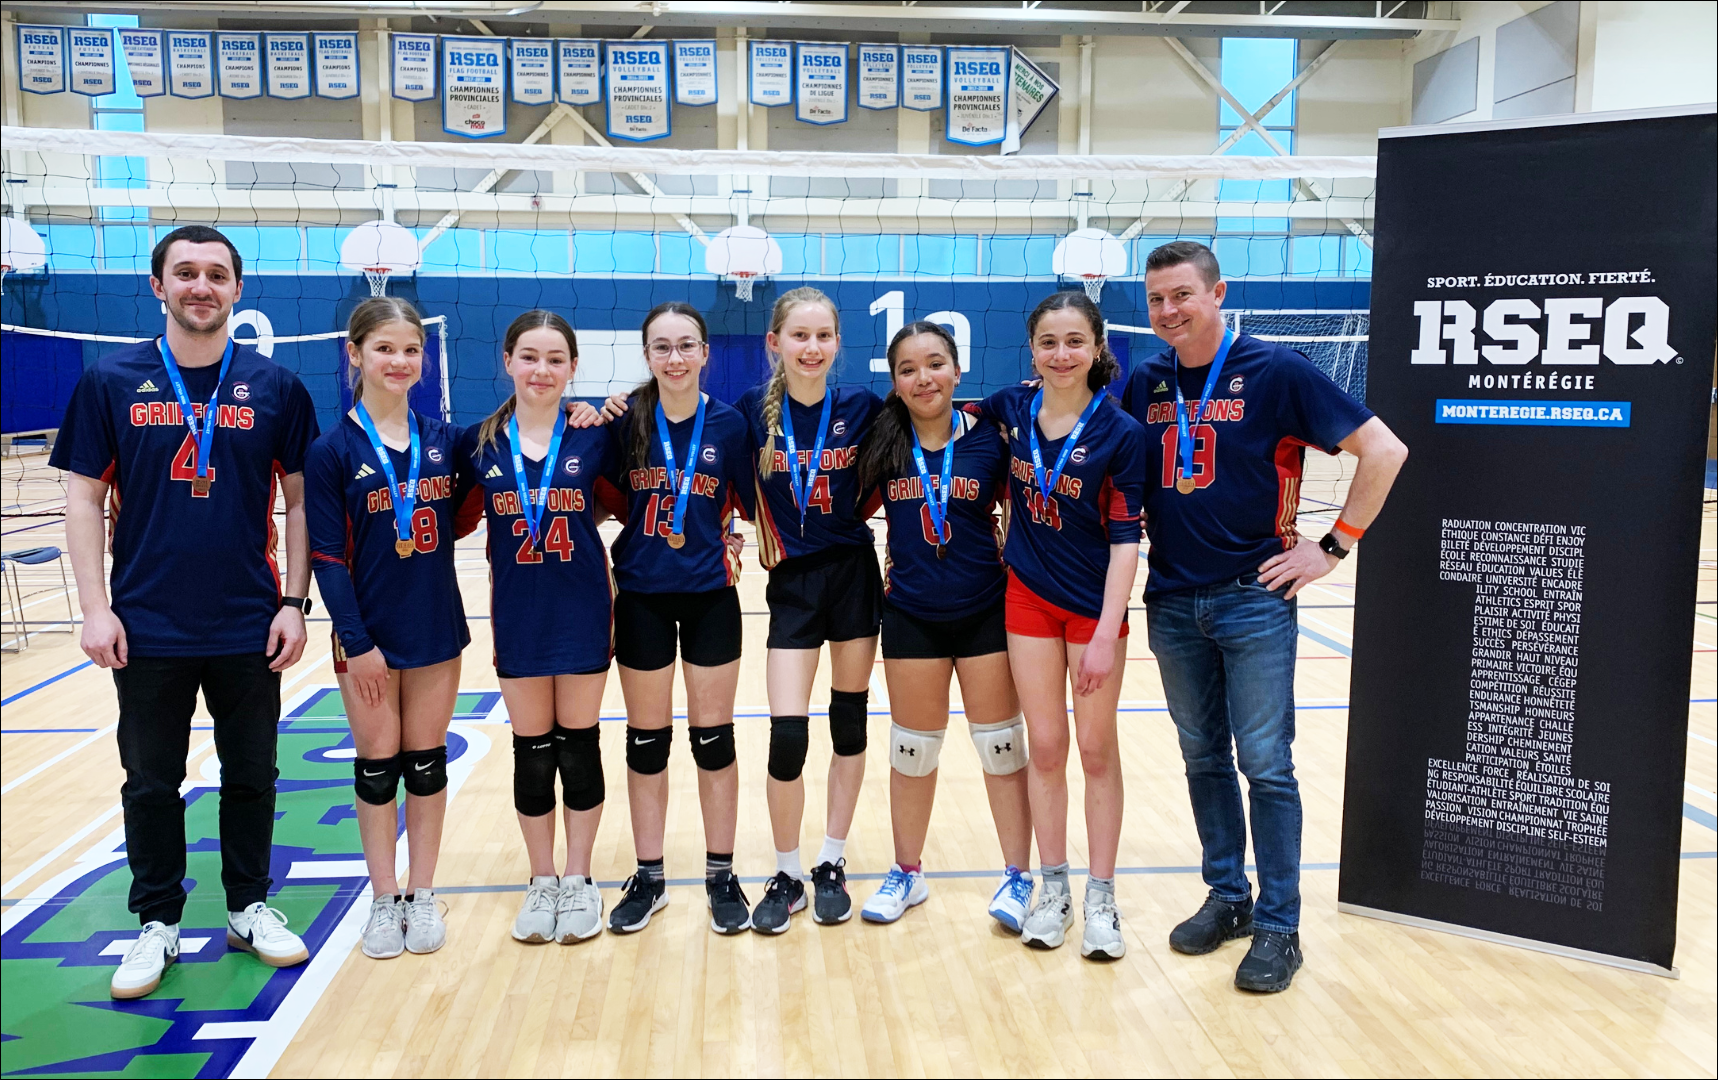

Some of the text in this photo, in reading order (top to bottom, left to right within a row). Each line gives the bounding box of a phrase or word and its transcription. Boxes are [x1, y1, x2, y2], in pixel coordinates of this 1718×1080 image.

[24, 34, 58, 45] RSEQ
[74, 36, 109, 47] RSEQ
[123, 35, 157, 45] RSEQ
[173, 38, 207, 47] RSEQ
[222, 41, 255, 50] RSEQ
[270, 41, 304, 51] RSEQ
[319, 39, 352, 49] RSEQ
[398, 41, 431, 51] RSEQ
[449, 52, 499, 67] RSEQ
[516, 48, 549, 57] RSEQ
[563, 48, 595, 58] RSEQ
[612, 51, 661, 65] RSEQ
[679, 47, 711, 56] RSEQ
[756, 47, 787, 57] RSEQ
[803, 55, 842, 67] RSEQ
[863, 53, 894, 62] RSEQ
[907, 54, 938, 63] RSEQ
[954, 62, 1001, 75] RSEQ
[1015, 63, 1030, 79] MERCI
[1034, 79, 1045, 91] NOS
[450, 86, 499, 94] CHAMPIONNES
[1014, 72, 1044, 103] TENAIRES
[450, 95, 499, 103] PROVINCIALES
[954, 95, 1001, 103] CHAMPIONNES
[1427, 268, 1656, 288] SPORT. ÉDUCATION. FIERTÉ.
[1411, 296, 1679, 365] RSEQ
[1468, 371, 1595, 390] MONTÉRÉGIE
[1442, 405, 1623, 421] MONTEREGIE.RSEQ.CA
[170, 429, 216, 498] 4
[759, 445, 858, 472] RFONS
[1161, 424, 1217, 489] 19
[1010, 454, 1083, 499] RIFONS
[367, 475, 452, 513] GRFONS
[644, 493, 686, 538] 13
[920, 501, 952, 545] 6
[1441, 519, 1586, 535] RADUATION CONCENTRATION VIC
[512, 516, 574, 564] 24
[1441, 528, 1585, 547] ÉTHIQUE CONSTANCE DÉFI ENJOY
[1440, 539, 1584, 557] BILETÉ DÉVELOPPEMENT DISCIPL
[1440, 549, 1584, 568] ÉCOLE RECONNAISSANCE STUDIE
[1439, 560, 1472, 572] RÉSEAU
[1476, 562, 1525, 575] ÉDUCATION
[1529, 567, 1563, 578] VALUES
[1439, 572, 1582, 590] CONDAIRE UNIVERSITÉ ENCADRE
[1476, 585, 1582, 601] ILITY SCHOOL ENTRAÎN
[1475, 596, 1581, 612] ATHLETICS ESPRIT SPOR
[1474, 606, 1580, 623] PLAISIR ACTIVITÉ PHYSI
[1472, 625, 1578, 644] É ETHICS DÉPASSEMENT
[1473, 617, 1579, 634] ESTIME DE SOI ÉDUCATI
[1472, 637, 1578, 656] SUCCÈS PERSÉVÉRANCE
[1471, 648, 1578, 666] GRANDIR HAUT NIVEAU
[1471, 659, 1577, 678] PRIMAIRE VICTOIRE ÉQU
[1471, 669, 1576, 688] APPRENTISSAGE CÉGEP
[1469, 679, 1575, 699] COMPÉTITION RÉUSSITE
[1469, 690, 1575, 710] ENDURANCE HONNÊTETÉ
[1469, 701, 1574, 721] TSMANSHIP HONNEURS
[1468, 712, 1573, 732] APPARTENANCE CHALLE
[1467, 722, 1573, 743] ESS INTÉGRITÉ JEUNES
[1466, 733, 1572, 754] DERSHIP CHEMINEMENT
[1466, 743, 1571, 764] CATION VALEURS SANTÉ
[1465, 754, 1571, 775] PARTICIPATION ÉTOILES
[1428, 759, 1610, 792] EXCELLENCE FORCE RÉALISATION DE SOI
[1427, 769, 1609, 803] NG RESPONSABILITÉ ÉQUILIBRE SCOLAIRE
[1426, 778, 1609, 815] ÉTUDIANT-ATHLÈTE SPORT TRADITION ÉQU
[1426, 790, 1608, 825] VALORISATION ENTRAÎNEMENT VIE SAINE
[1425, 800, 1607, 836] PASSION VISION CHAMPIONNAT TROPHÉE
[1424, 809, 1607, 847] DÉVELOPPEMENT DISCIPLINE SELF-ESTEEM
